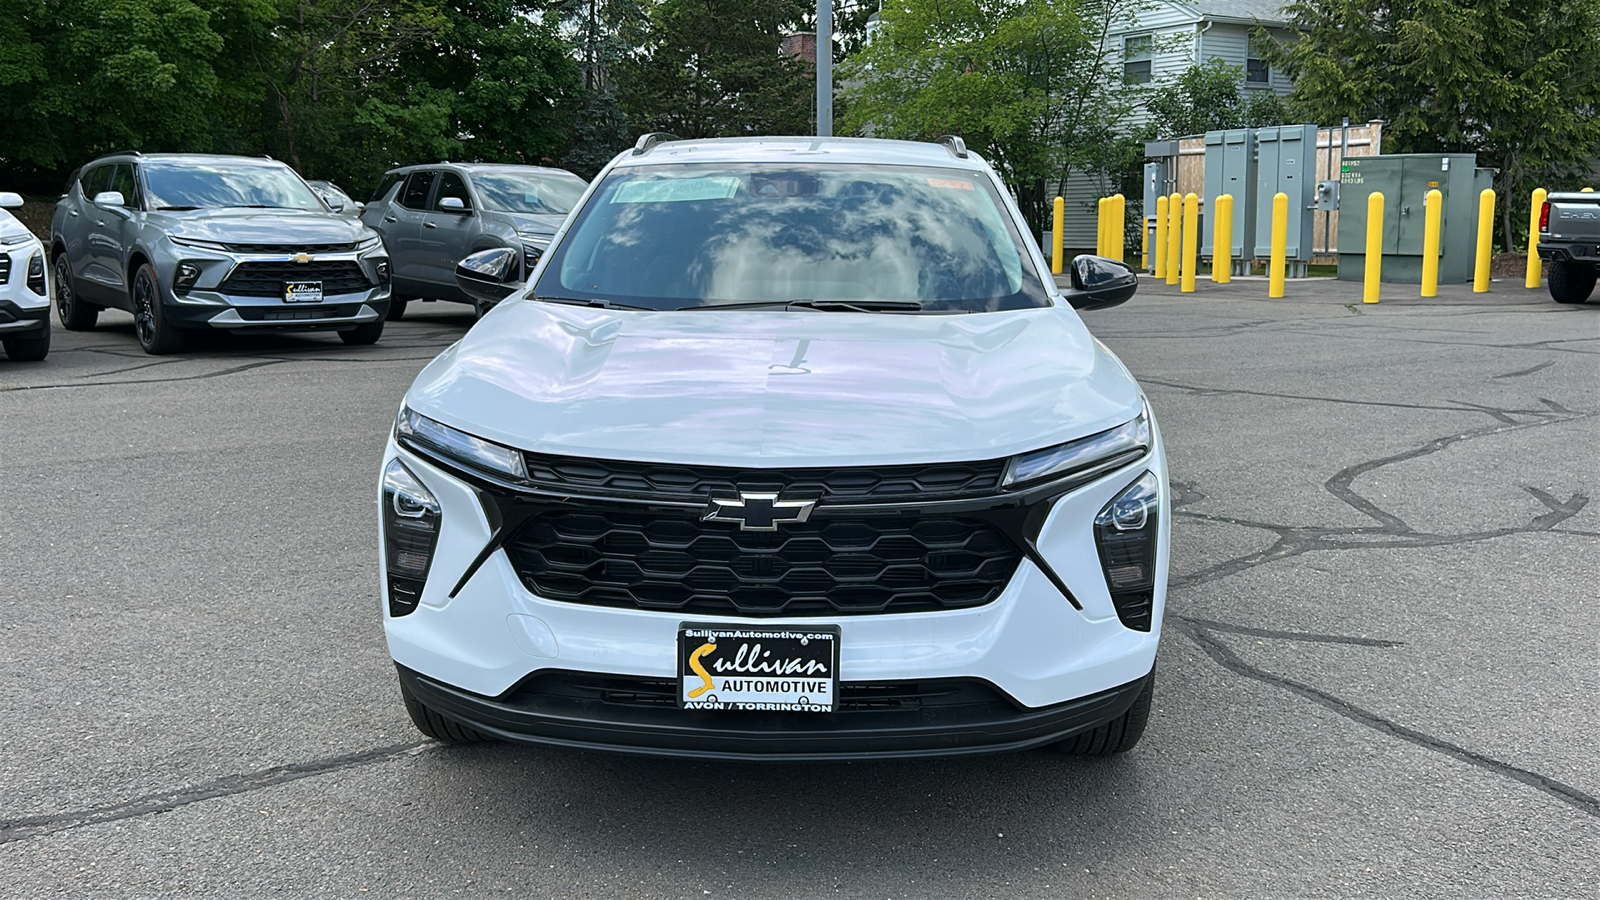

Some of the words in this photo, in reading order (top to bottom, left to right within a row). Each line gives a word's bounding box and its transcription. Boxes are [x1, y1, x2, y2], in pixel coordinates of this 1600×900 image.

[685, 630, 833, 640] SullivanAutomotive.com
[687, 642, 828, 698] Sullivan
[722, 680, 827, 693] AUTOMOTIVE
[684, 702, 725, 710] AVON
[736, 703, 832, 712] TORRINGTON
